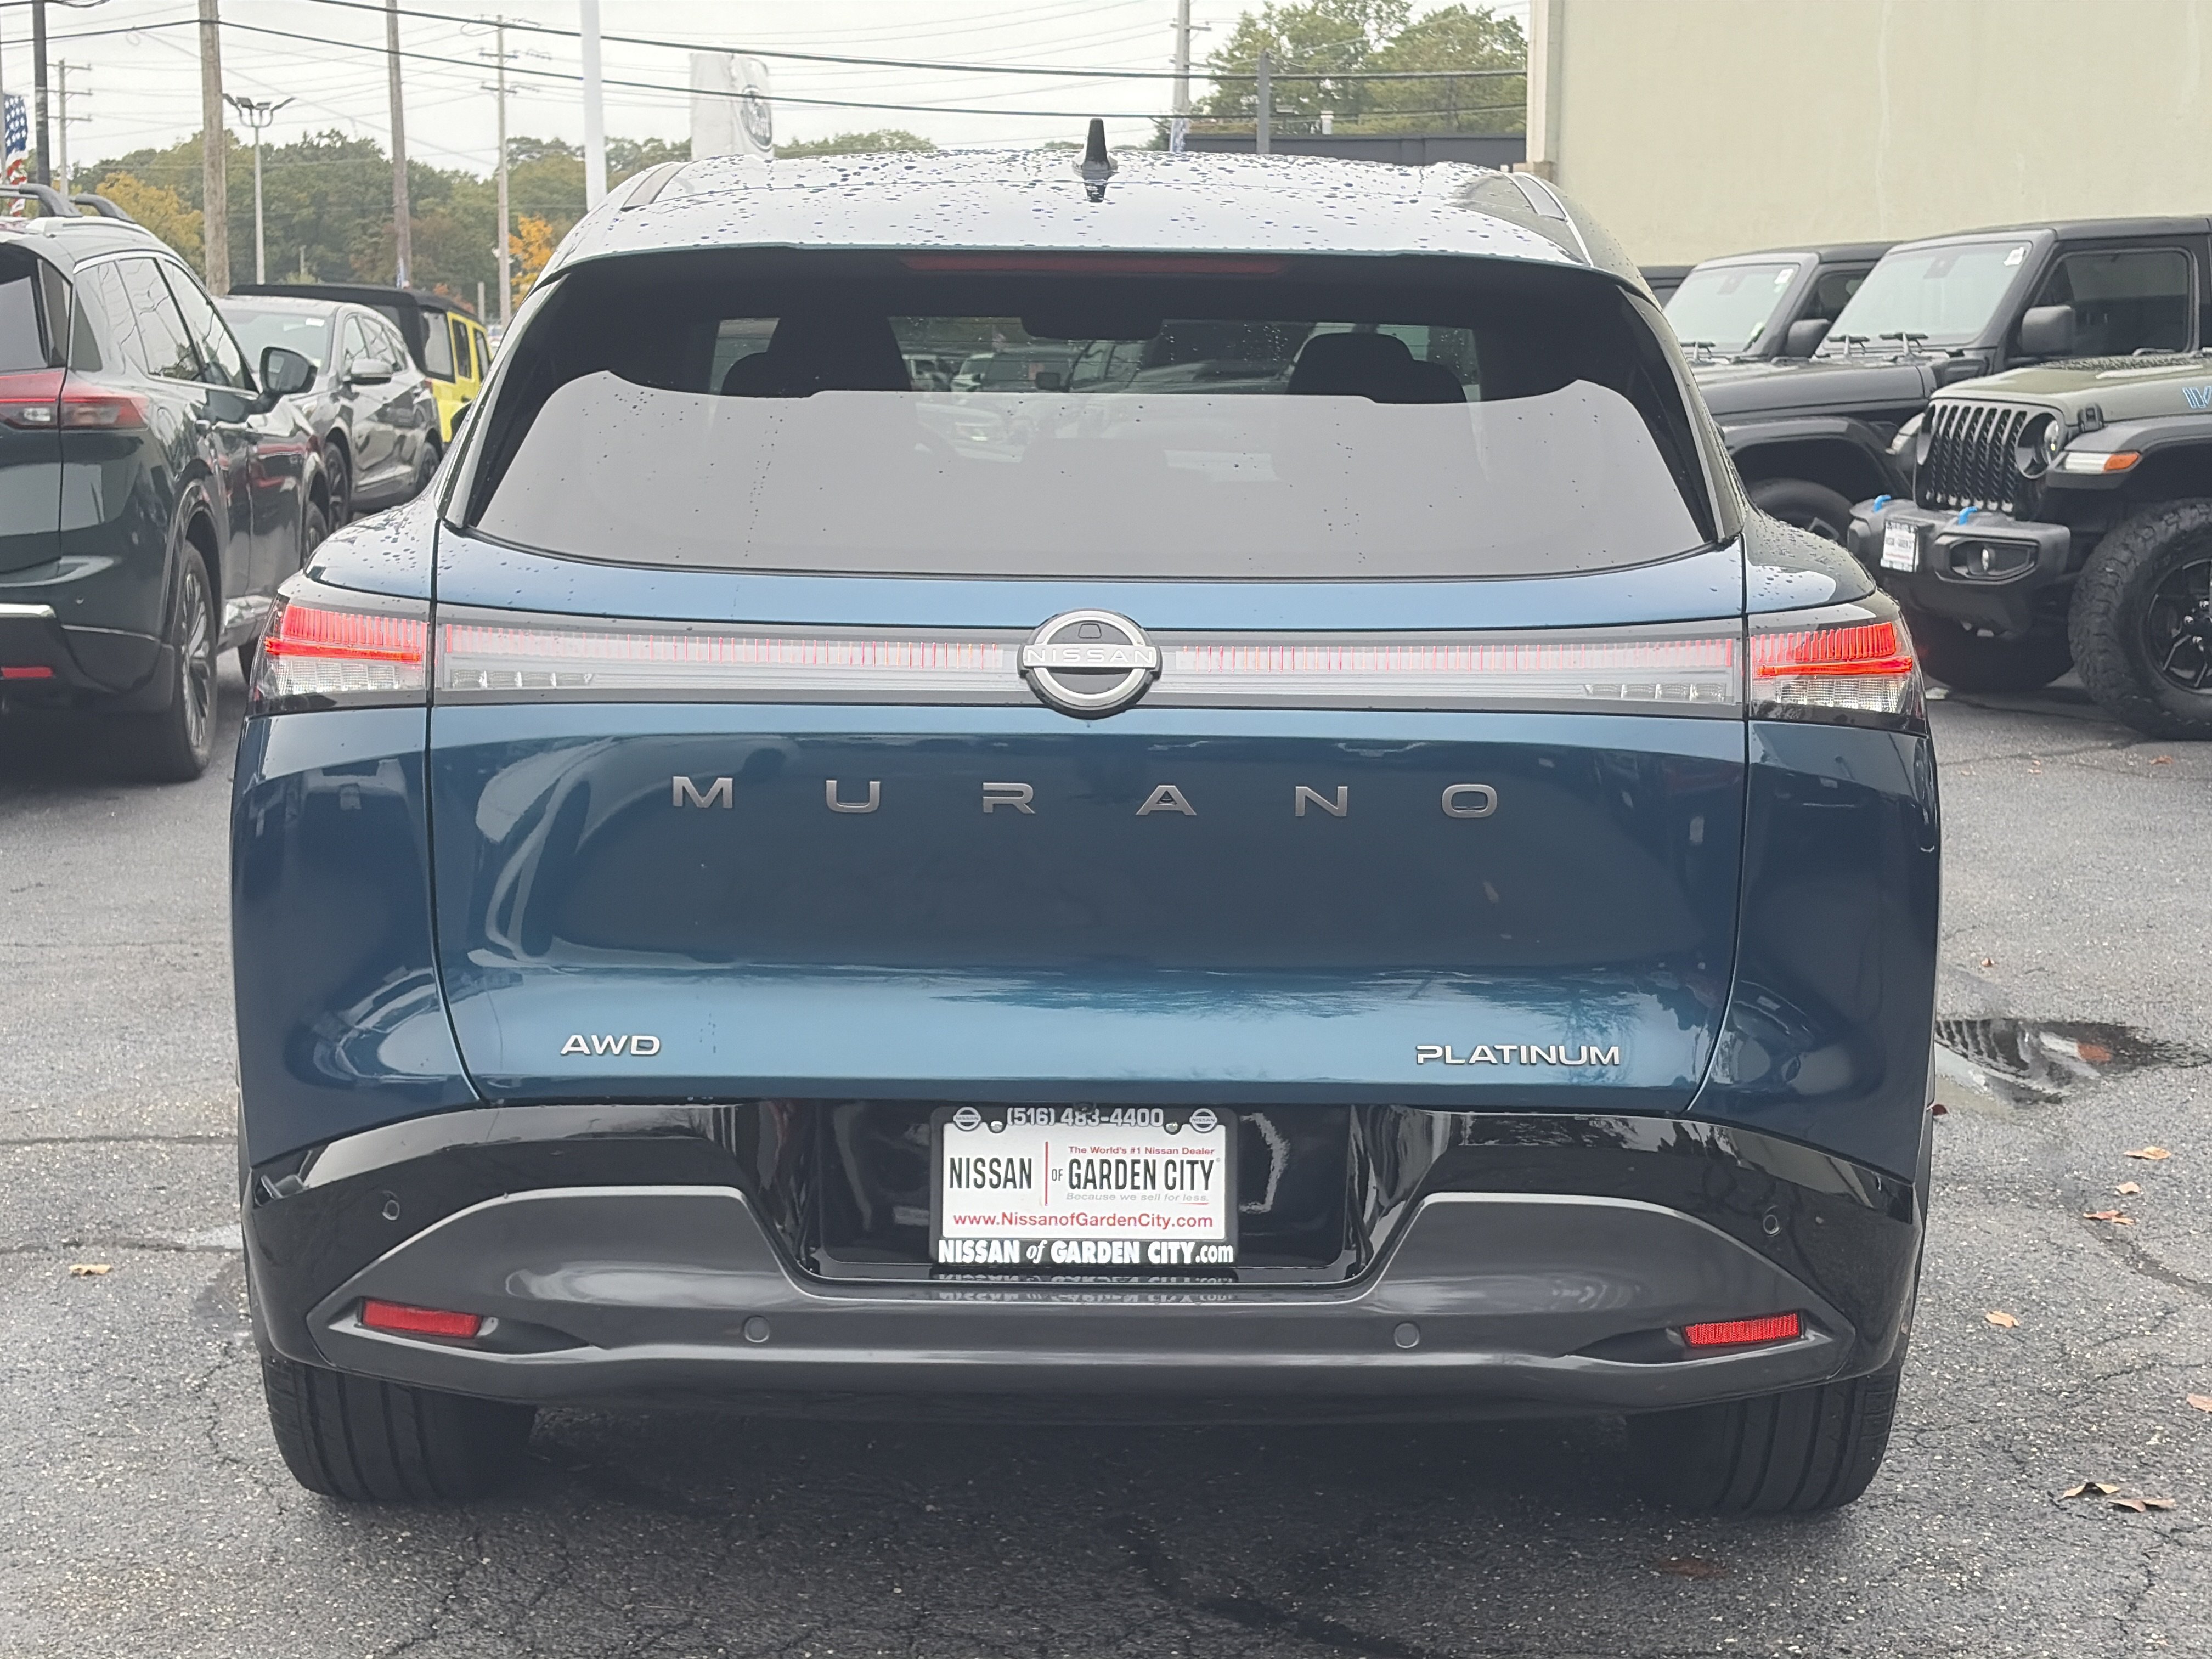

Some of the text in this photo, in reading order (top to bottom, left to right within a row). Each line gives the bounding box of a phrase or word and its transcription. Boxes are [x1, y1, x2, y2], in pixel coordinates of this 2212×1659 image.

[1027, 648, 1152, 663] NISSAN
[672, 776, 1498, 817] MURANO
[560, 1035, 661, 1056] AWD
[1416, 1045, 1620, 1065] PLATINUM
[1007, 1107, 1164, 1127] (516) 483-4400
[1069, 1146, 1087, 1154] The
[1090, 1146, 1127, 1155] World's
[1144, 1147, 1178, 1155] Nissan
[1182, 1147, 1215, 1155] Dealer
[949, 1158, 1032, 1189] NISSAN
[1051, 1158, 1214, 1191] OF GARDEN CITY
[1066, 1193, 1116, 1201] Because
[1141, 1193, 1161, 1201] sell
[953, 1212, 1213, 1228] www.NissanofGardenCity.com
[938, 1239, 1234, 1264] NISSAN of GARDEN CITY.com
